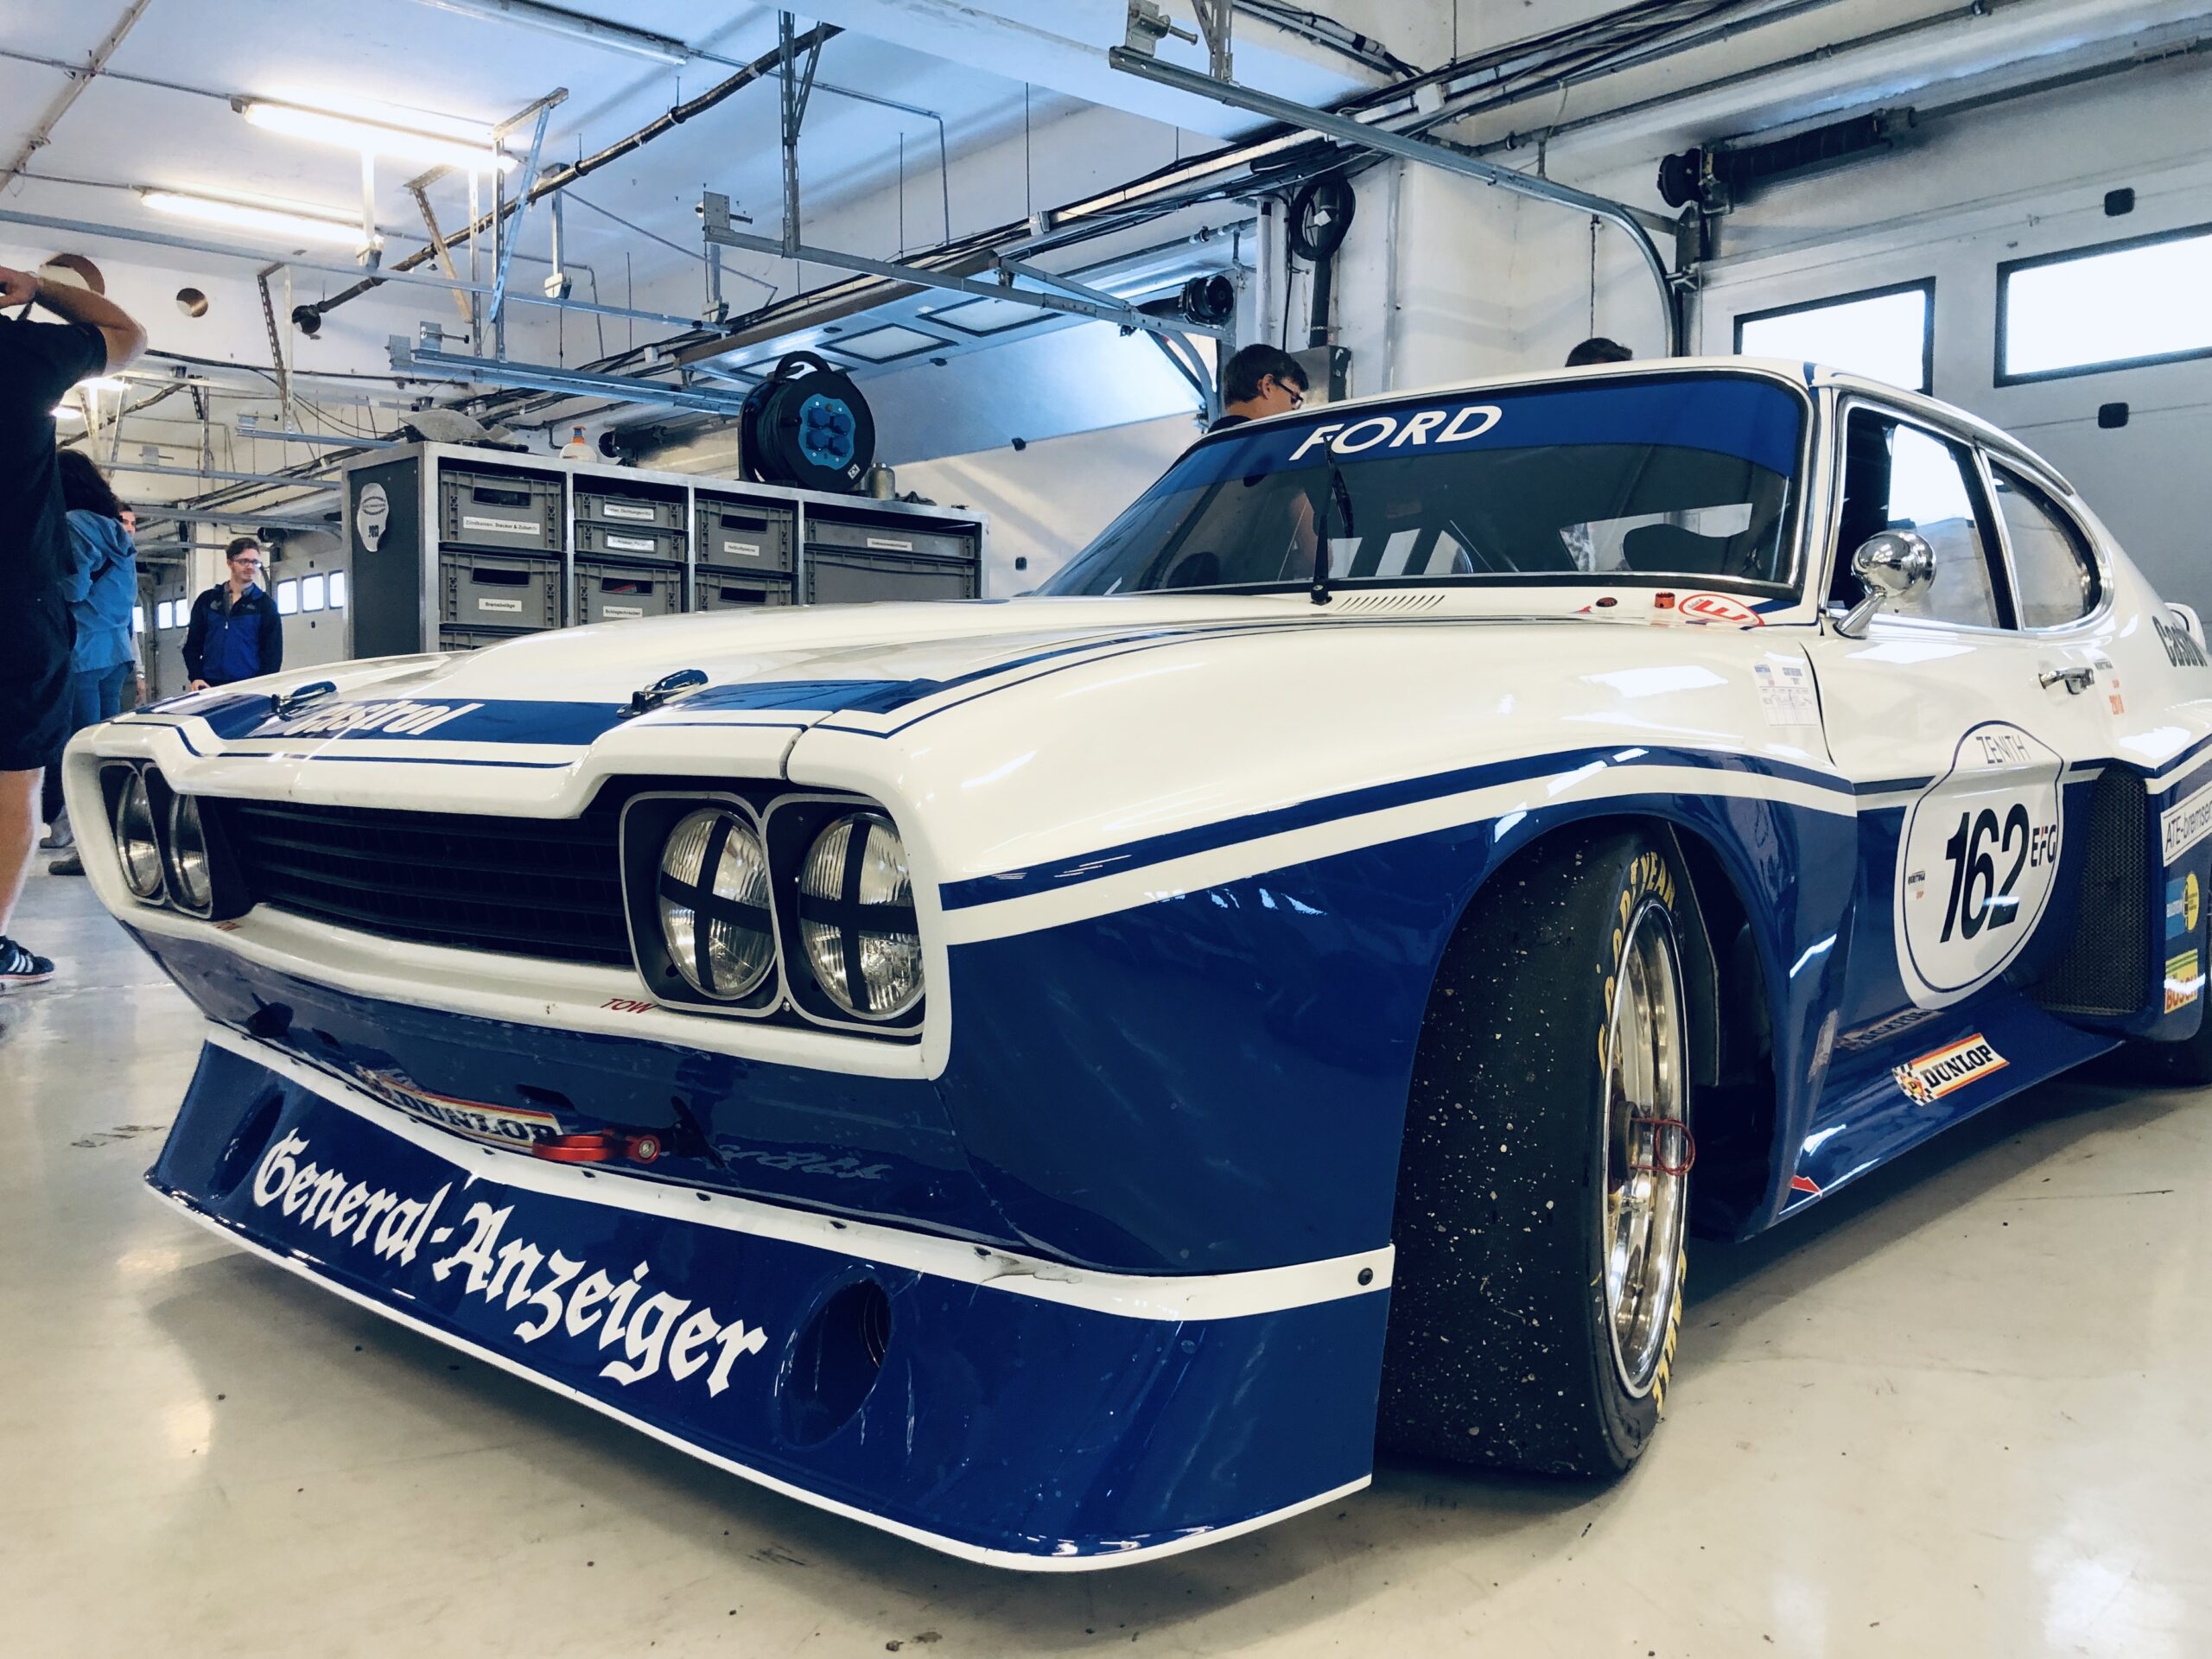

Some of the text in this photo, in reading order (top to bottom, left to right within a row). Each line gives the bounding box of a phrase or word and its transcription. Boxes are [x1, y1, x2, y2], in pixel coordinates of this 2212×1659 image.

[1288, 405, 1503, 461] FORD
[1976, 736, 2031, 764] ZENITH
[2031, 824, 2056, 867] EFG
[1940, 804, 2030, 943] 162
[600, 998, 659, 1014] TOW
[1920, 1044, 1993, 1089] DUNLOP
[394, 1089, 558, 1143] DUNLOP
[253, 1128, 768, 1398] General-Anzeiger
